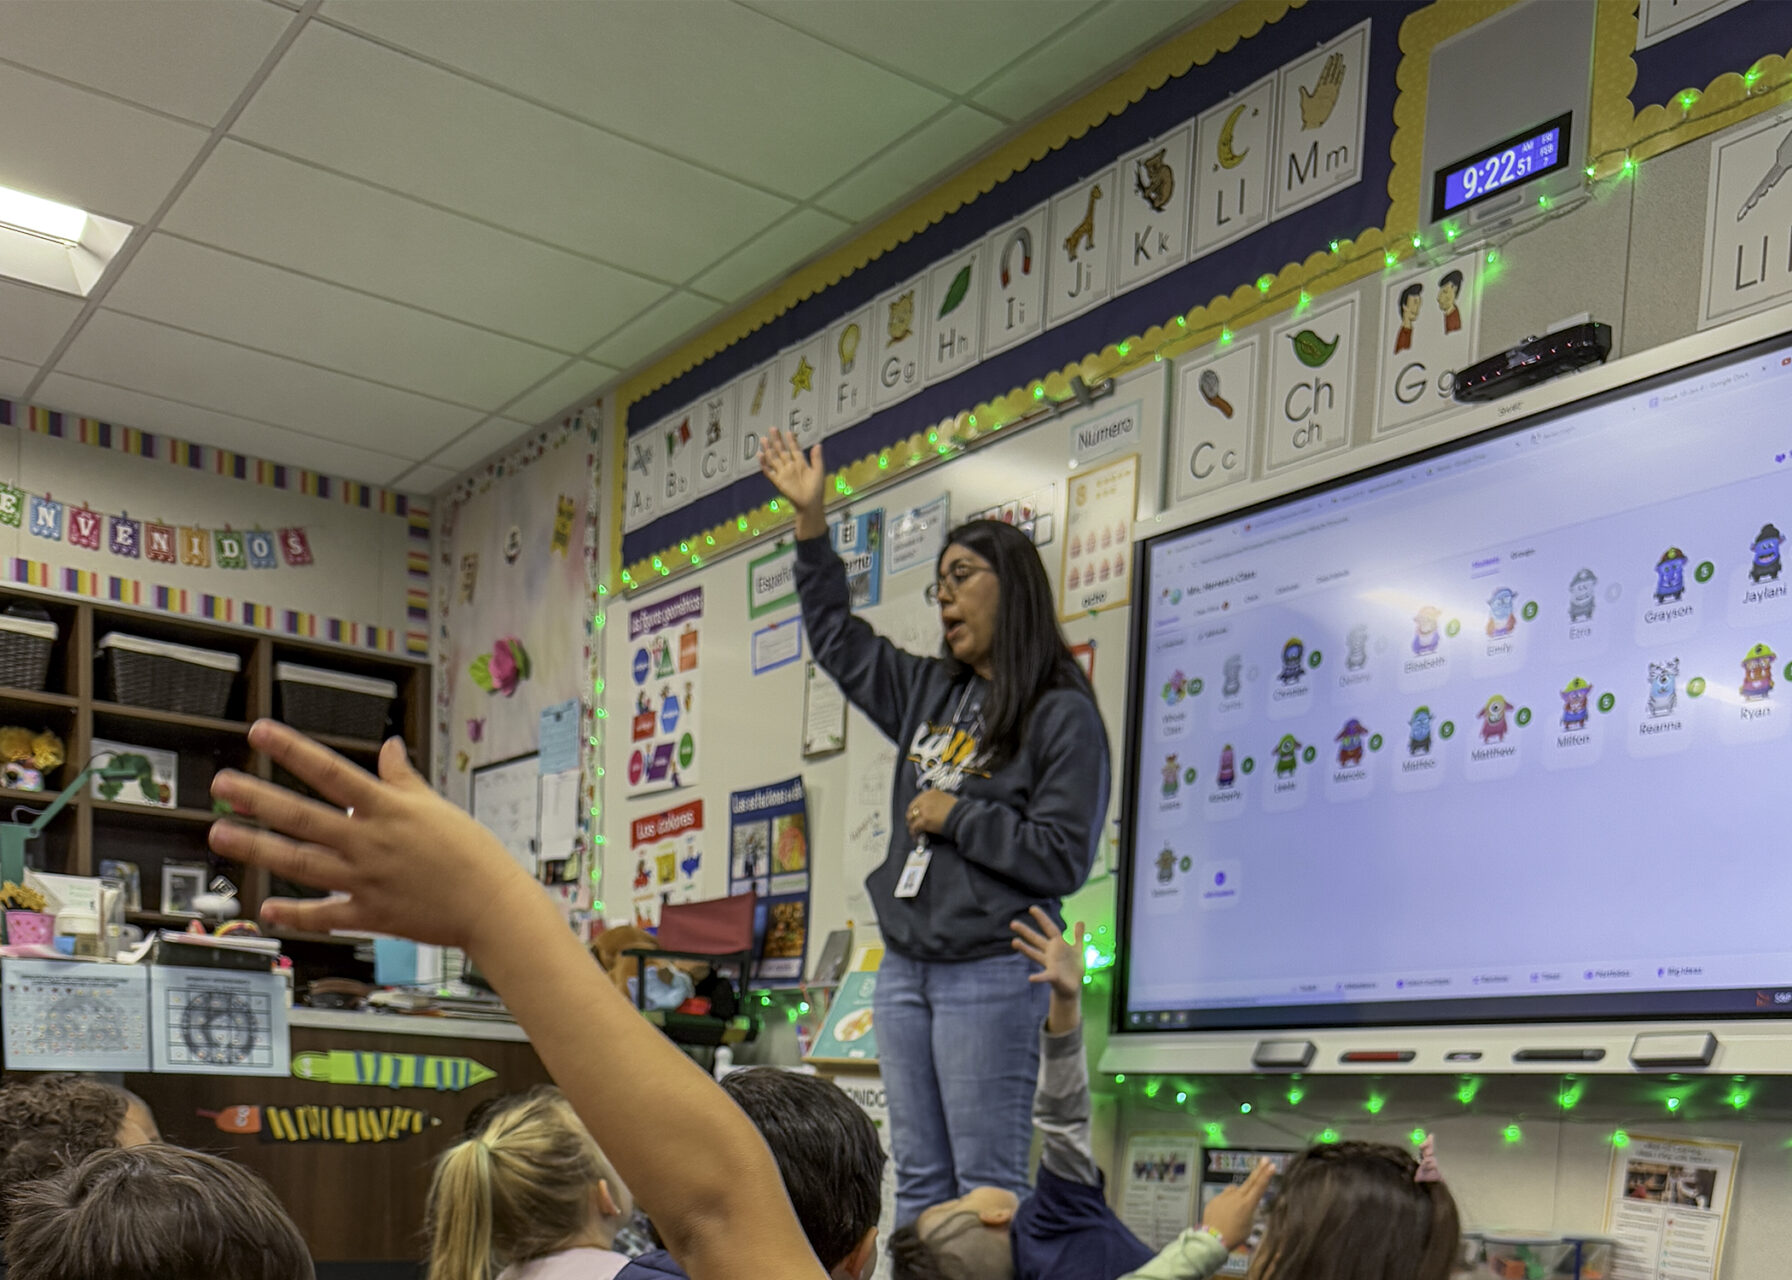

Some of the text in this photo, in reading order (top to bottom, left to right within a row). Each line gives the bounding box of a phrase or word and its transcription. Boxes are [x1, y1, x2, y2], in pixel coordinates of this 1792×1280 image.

[1287, 140, 1349, 192] Mm
[1462, 150, 1516, 199] 9:22
[1284, 376, 1334, 422] Ch
[1292, 420, 1323, 449] ch
[1190, 441, 1239, 480] Cc
[1741, 584, 1788, 604] Jaylani
[1643, 604, 1694, 625] Grayson
